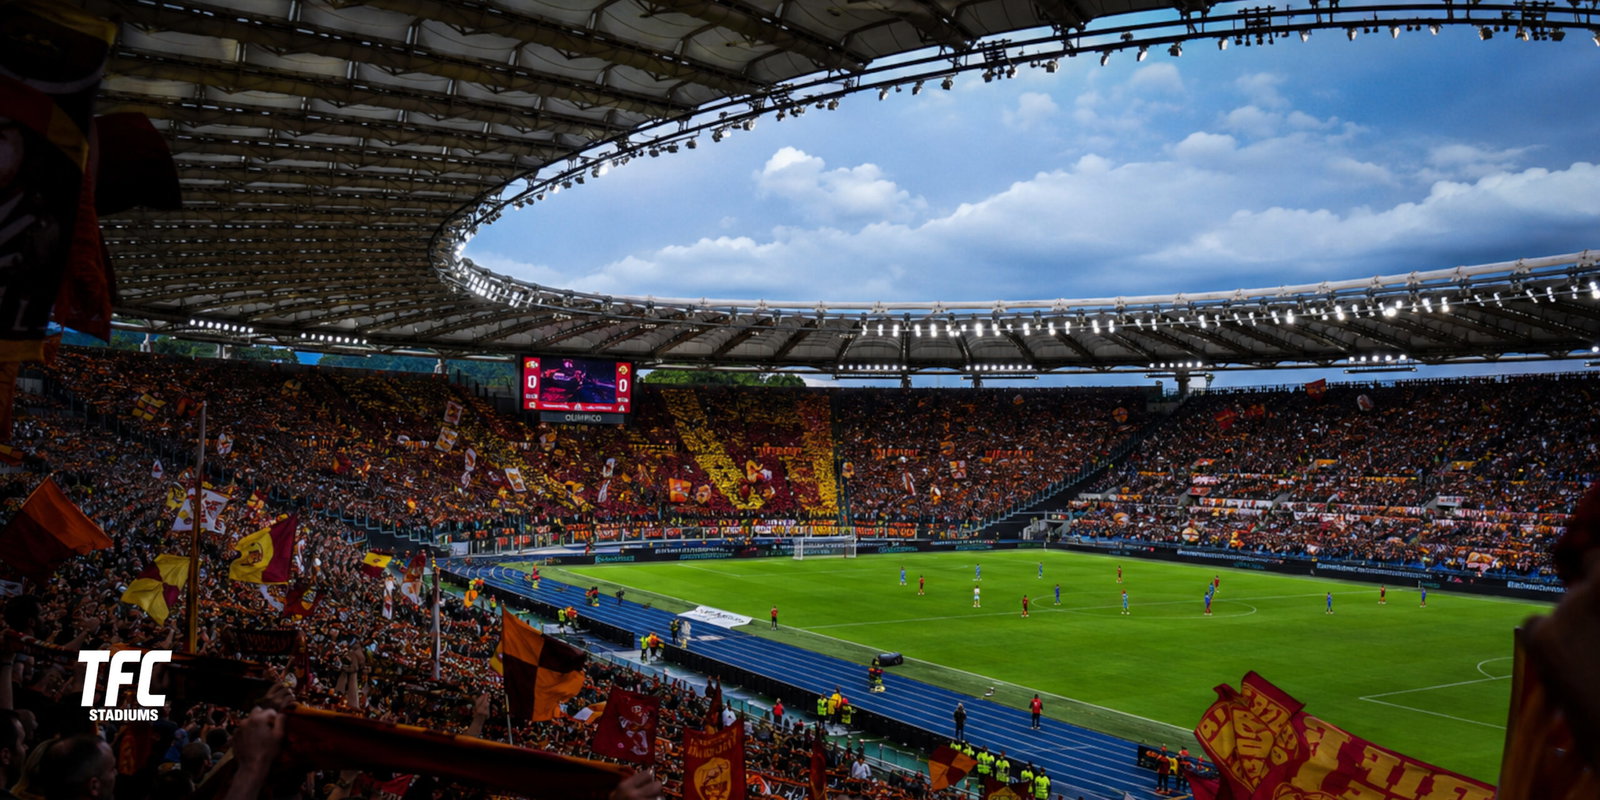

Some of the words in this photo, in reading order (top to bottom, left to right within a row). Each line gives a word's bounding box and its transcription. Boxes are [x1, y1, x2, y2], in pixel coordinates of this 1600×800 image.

[528, 375, 537, 388] 0
[619, 379, 628, 392] 0
[565, 414, 602, 422] OLIMPICO
